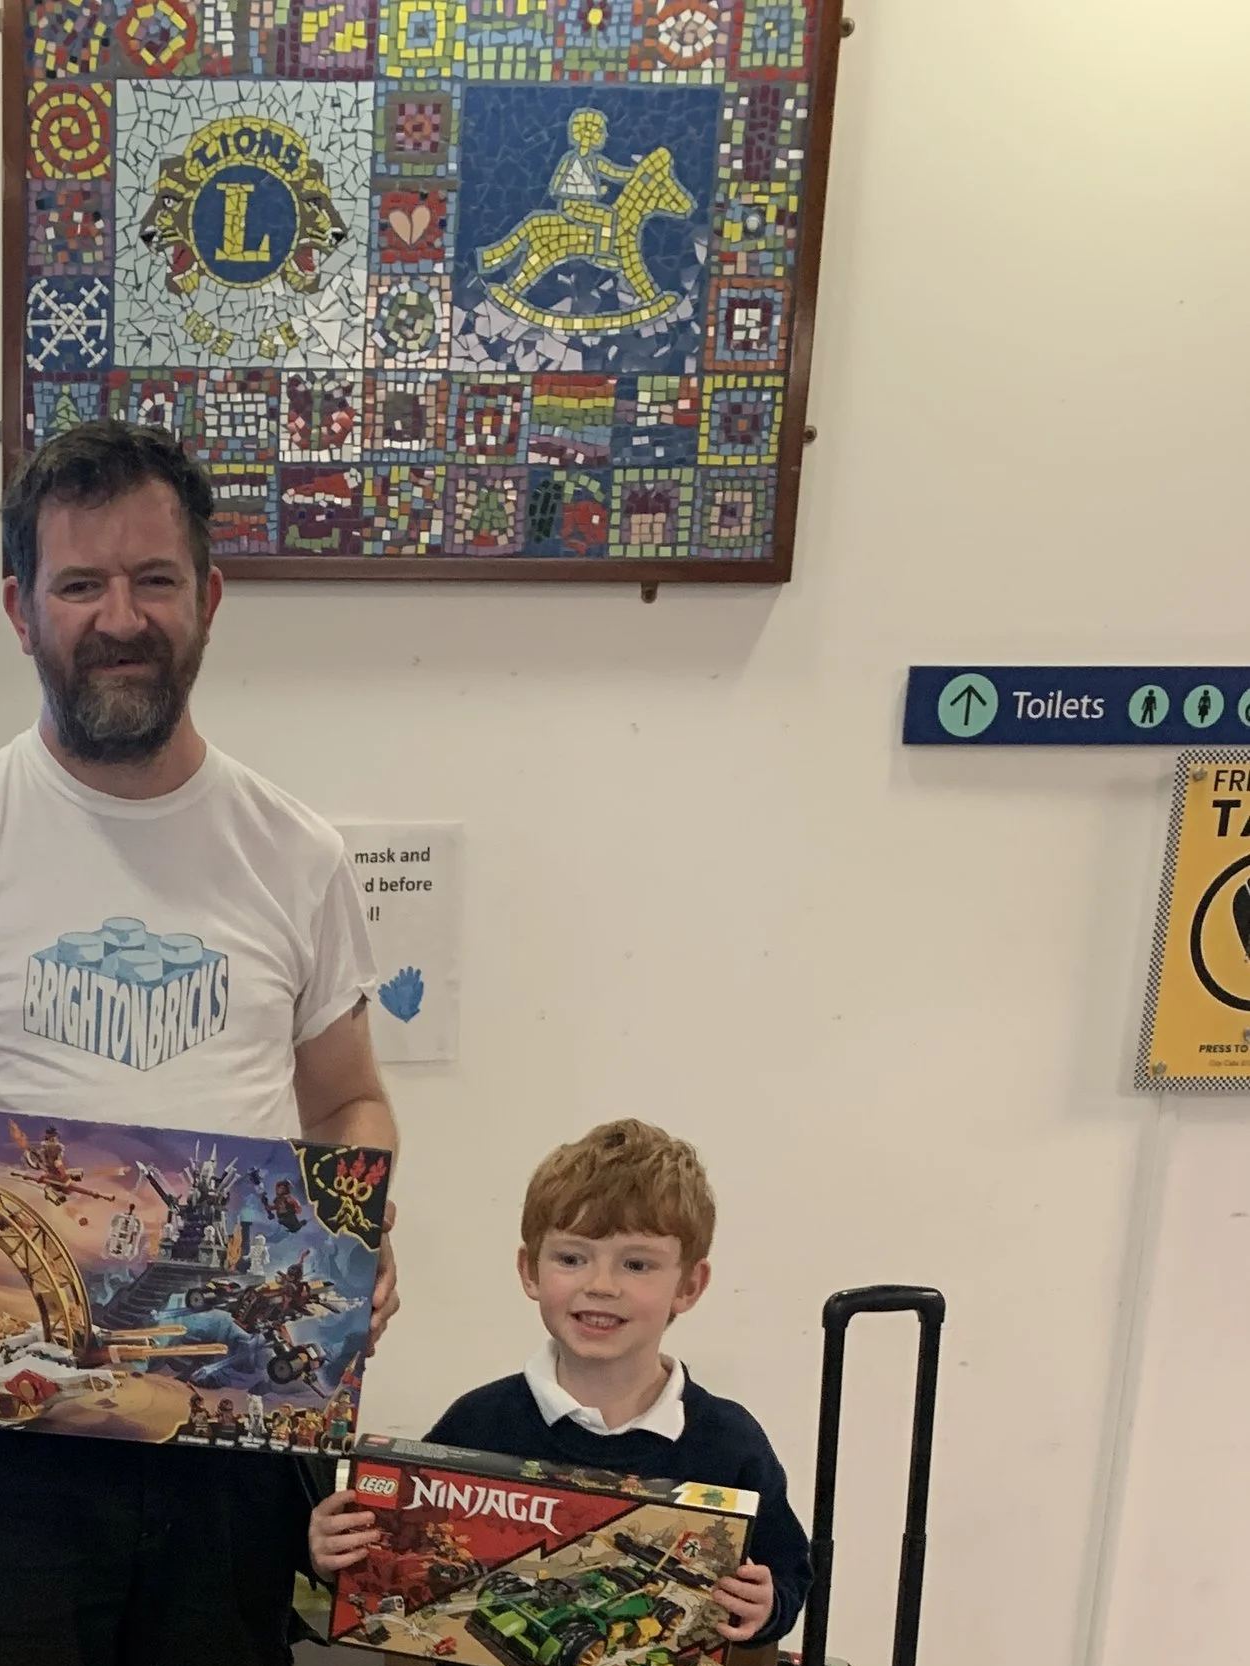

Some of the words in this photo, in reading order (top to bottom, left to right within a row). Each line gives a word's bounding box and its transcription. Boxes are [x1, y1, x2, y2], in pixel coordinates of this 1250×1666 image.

[193, 127, 302, 173] LIONS
[214, 182, 271, 262] L
[1012, 690, 1105, 719] Toilets
[354, 848, 396, 864] mask
[400, 847, 431, 863] and
[379, 876, 432, 893] before
[23, 955, 150, 1070] BRIGHTON
[149, 956, 229, 1070] BRICKS
[1198, 1044, 1232, 1054] PRESS
[358, 1475, 398, 1496] LEGO
[402, 1474, 563, 1536] NINJAGO
